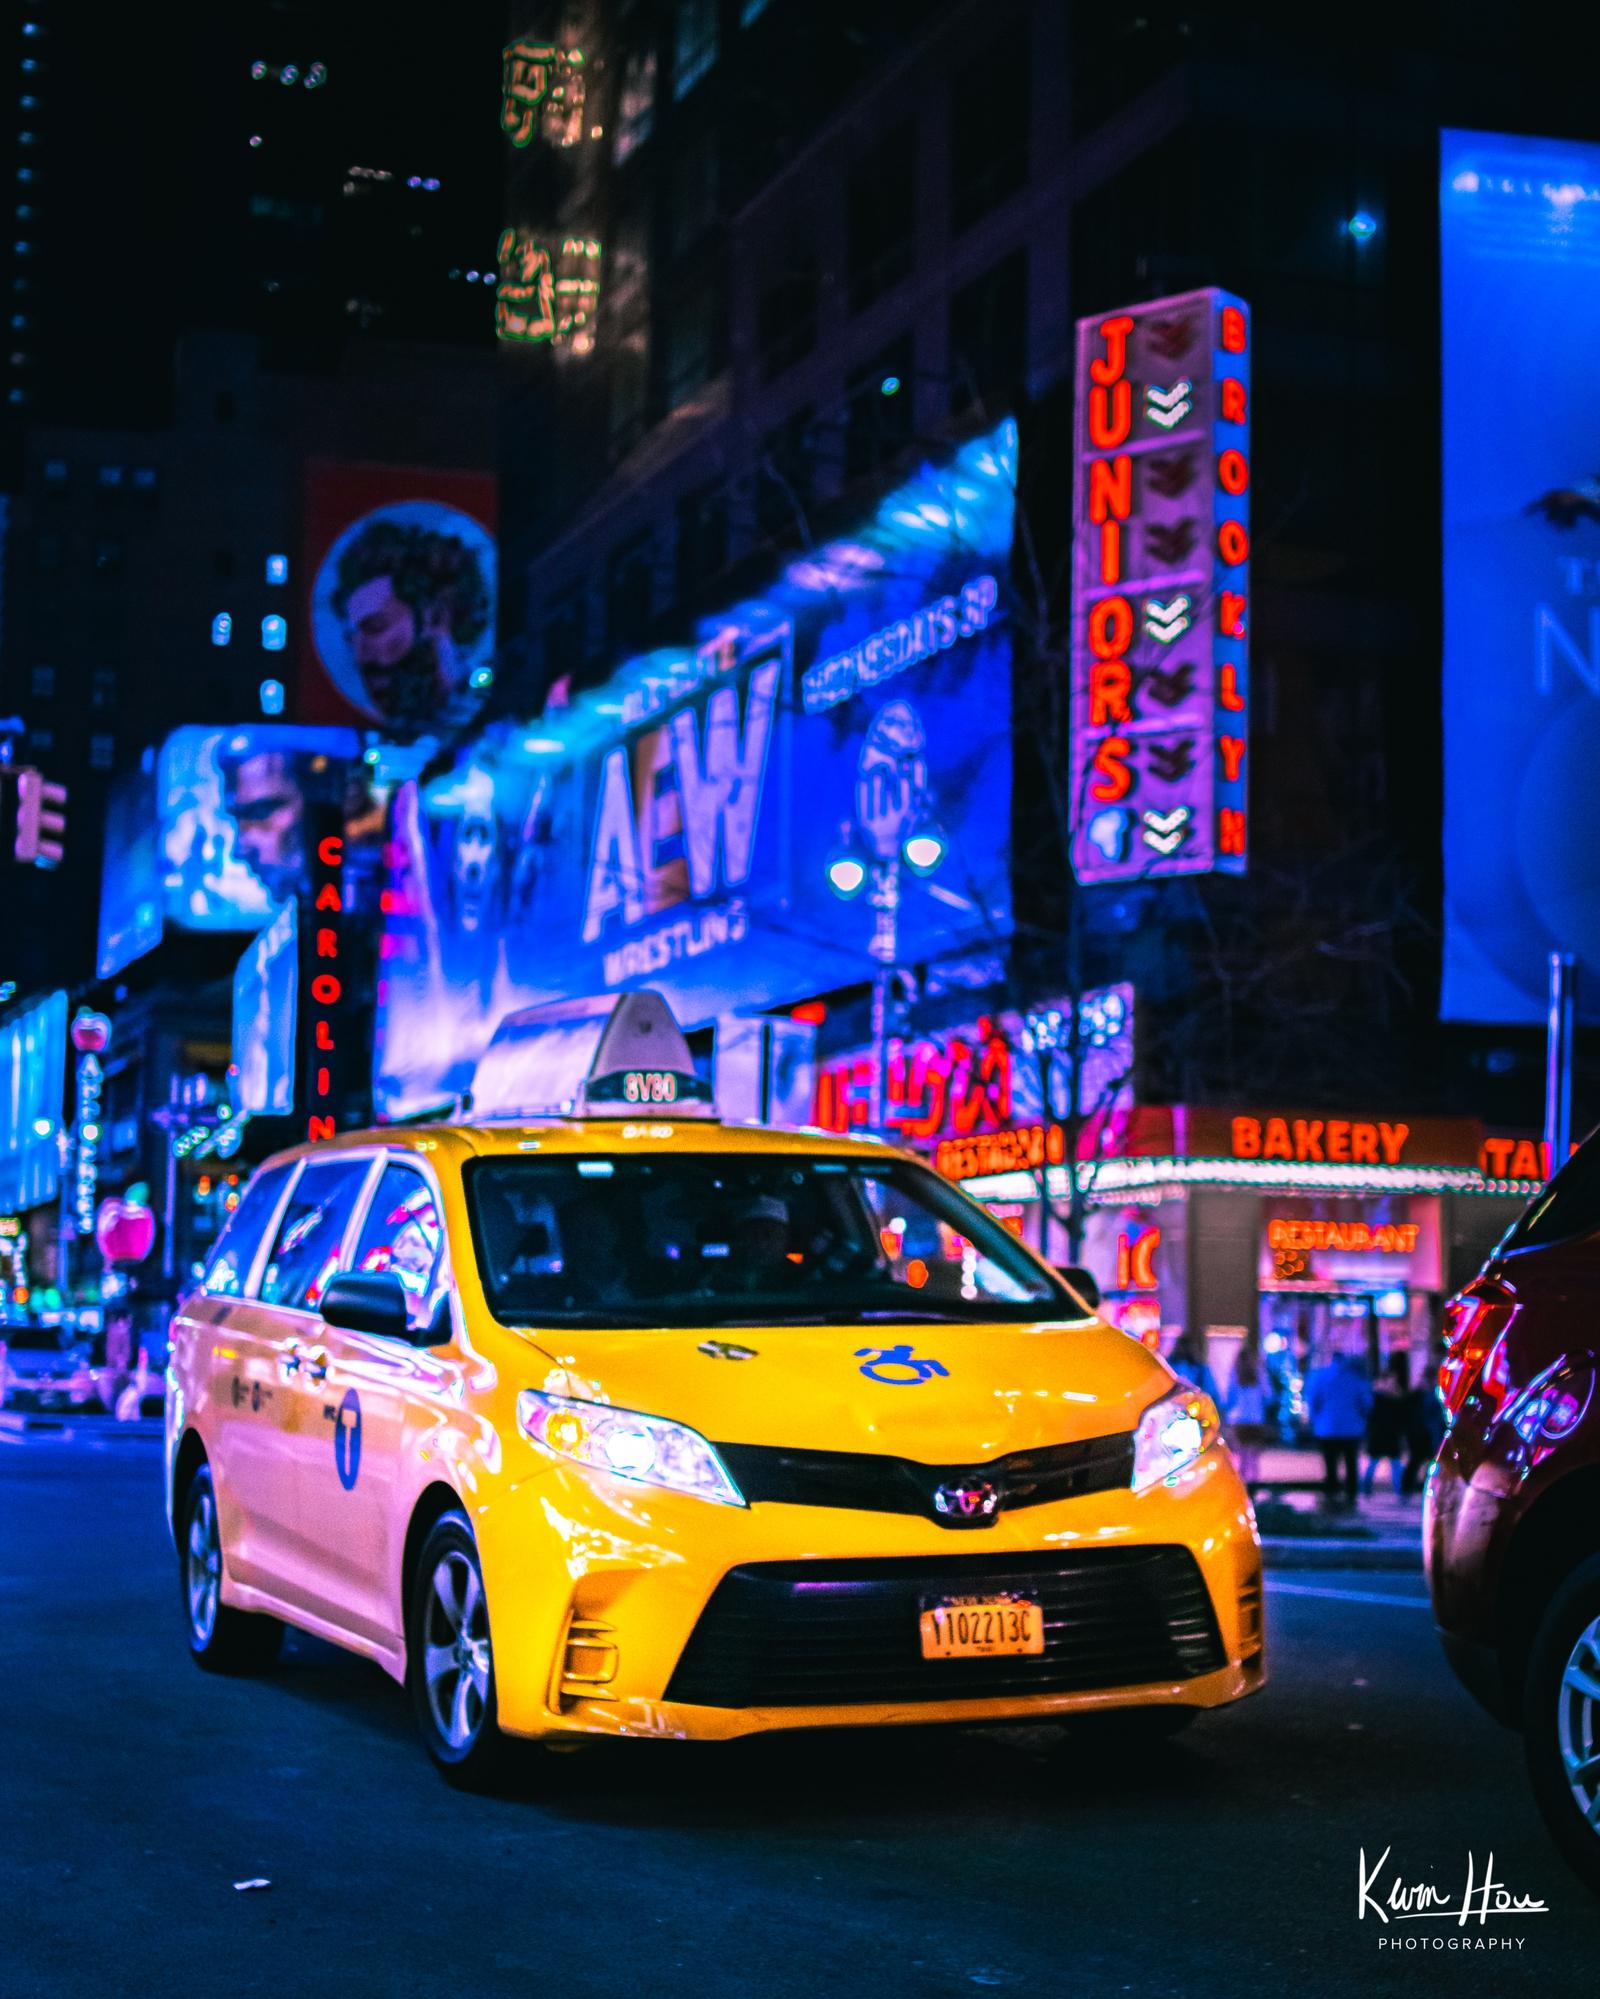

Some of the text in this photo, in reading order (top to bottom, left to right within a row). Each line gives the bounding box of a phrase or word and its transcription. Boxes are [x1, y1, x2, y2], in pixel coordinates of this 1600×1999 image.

[1219, 306, 1249, 855] BROOKLYN
[582, 661, 781, 944] AEW
[308, 836, 343, 1143] CAROLIN
[1232, 1116, 1409, 1164] BAKERY
[1267, 1218, 1420, 1253] RESTAURANT
